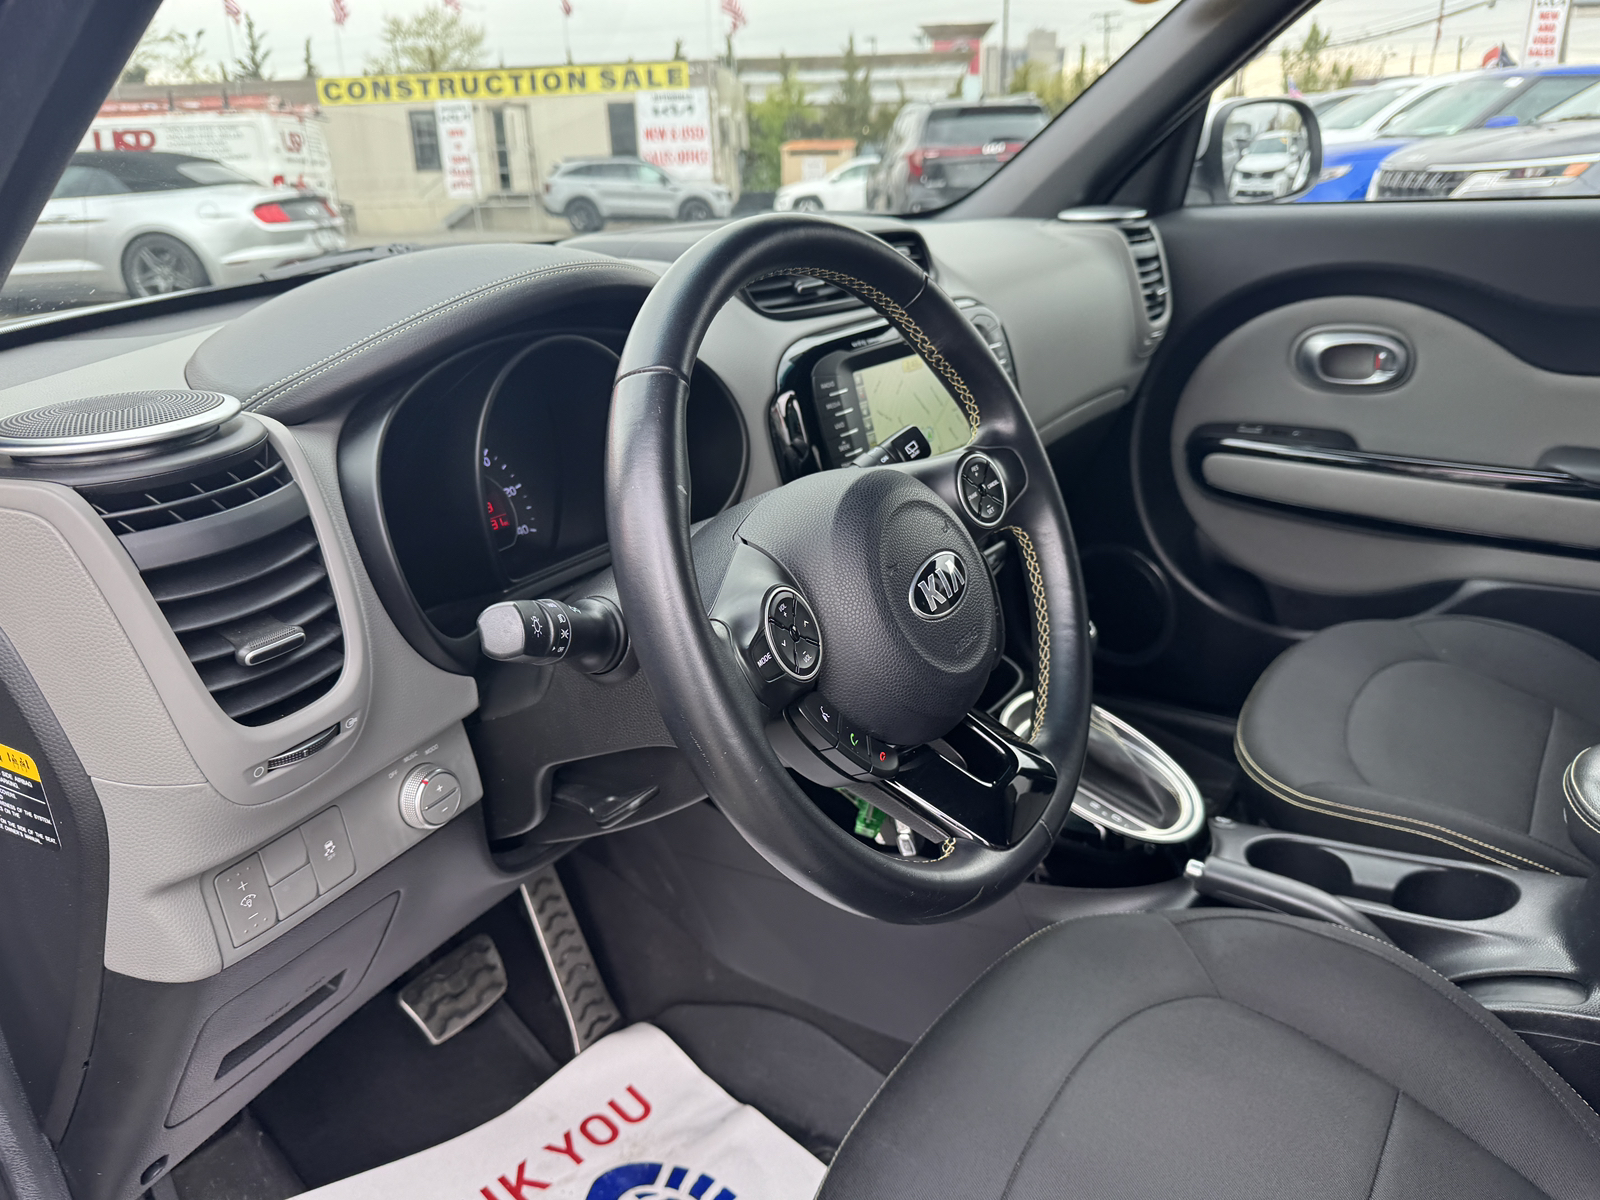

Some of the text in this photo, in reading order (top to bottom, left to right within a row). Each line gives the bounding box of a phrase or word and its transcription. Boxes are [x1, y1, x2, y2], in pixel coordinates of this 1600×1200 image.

[324, 67, 684, 100] CONSTRUCTION SALE
[917, 559, 966, 612] KIA
[757, 652, 773, 668] MODE
[543, 1084, 652, 1165] YOU
